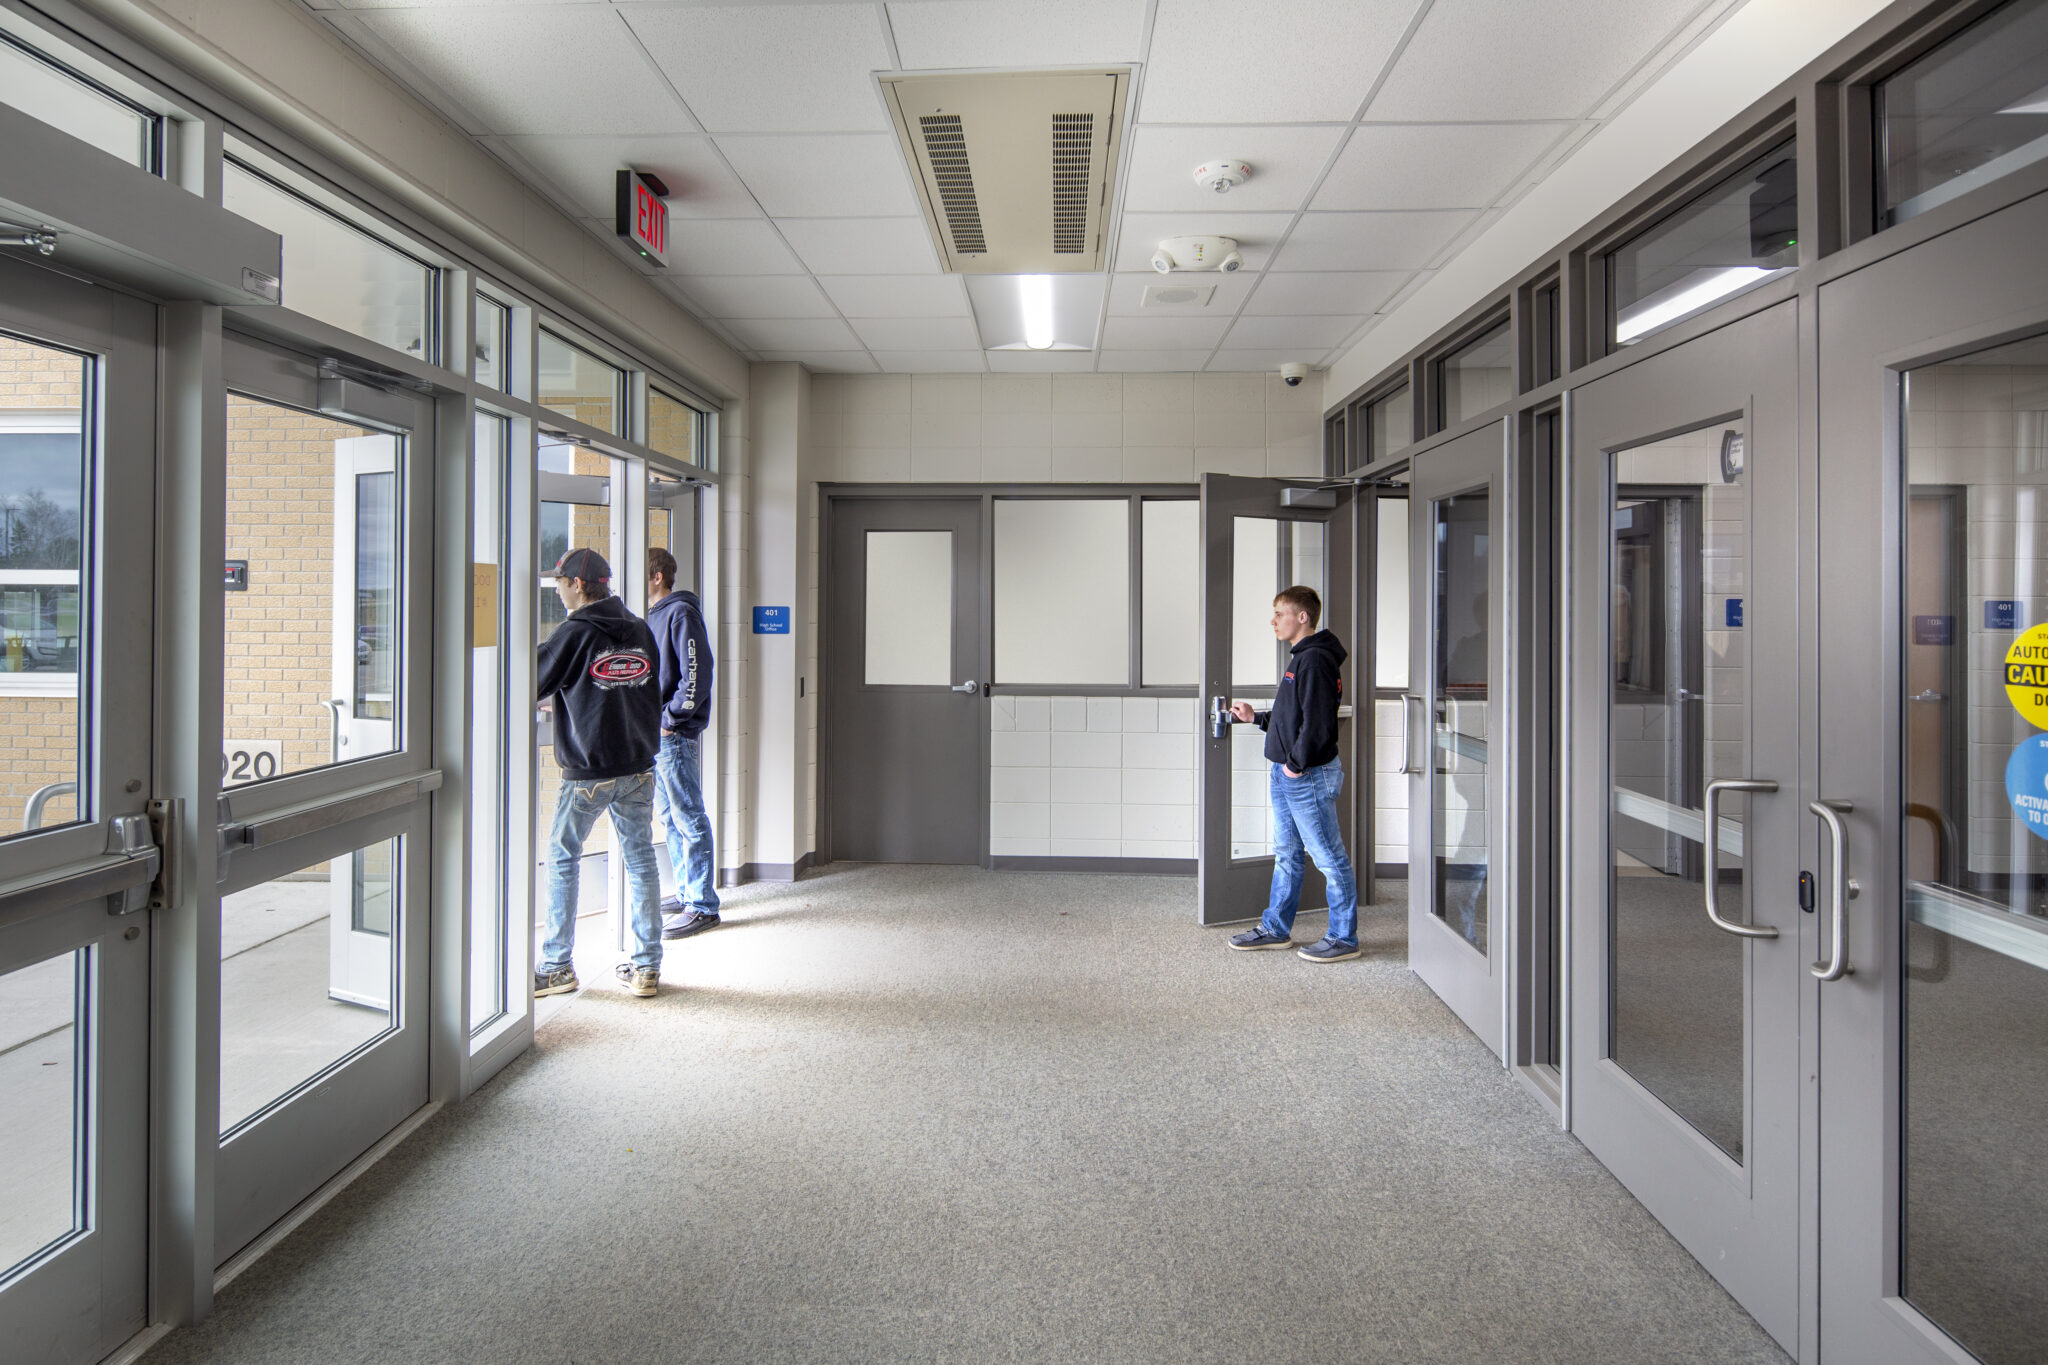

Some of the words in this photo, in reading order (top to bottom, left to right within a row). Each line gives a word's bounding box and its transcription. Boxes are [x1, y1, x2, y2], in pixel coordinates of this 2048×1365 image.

[637, 183, 665, 254] EXIT
[686, 638, 698, 699] carhartt
[2028, 809, 2041, 823] TO
